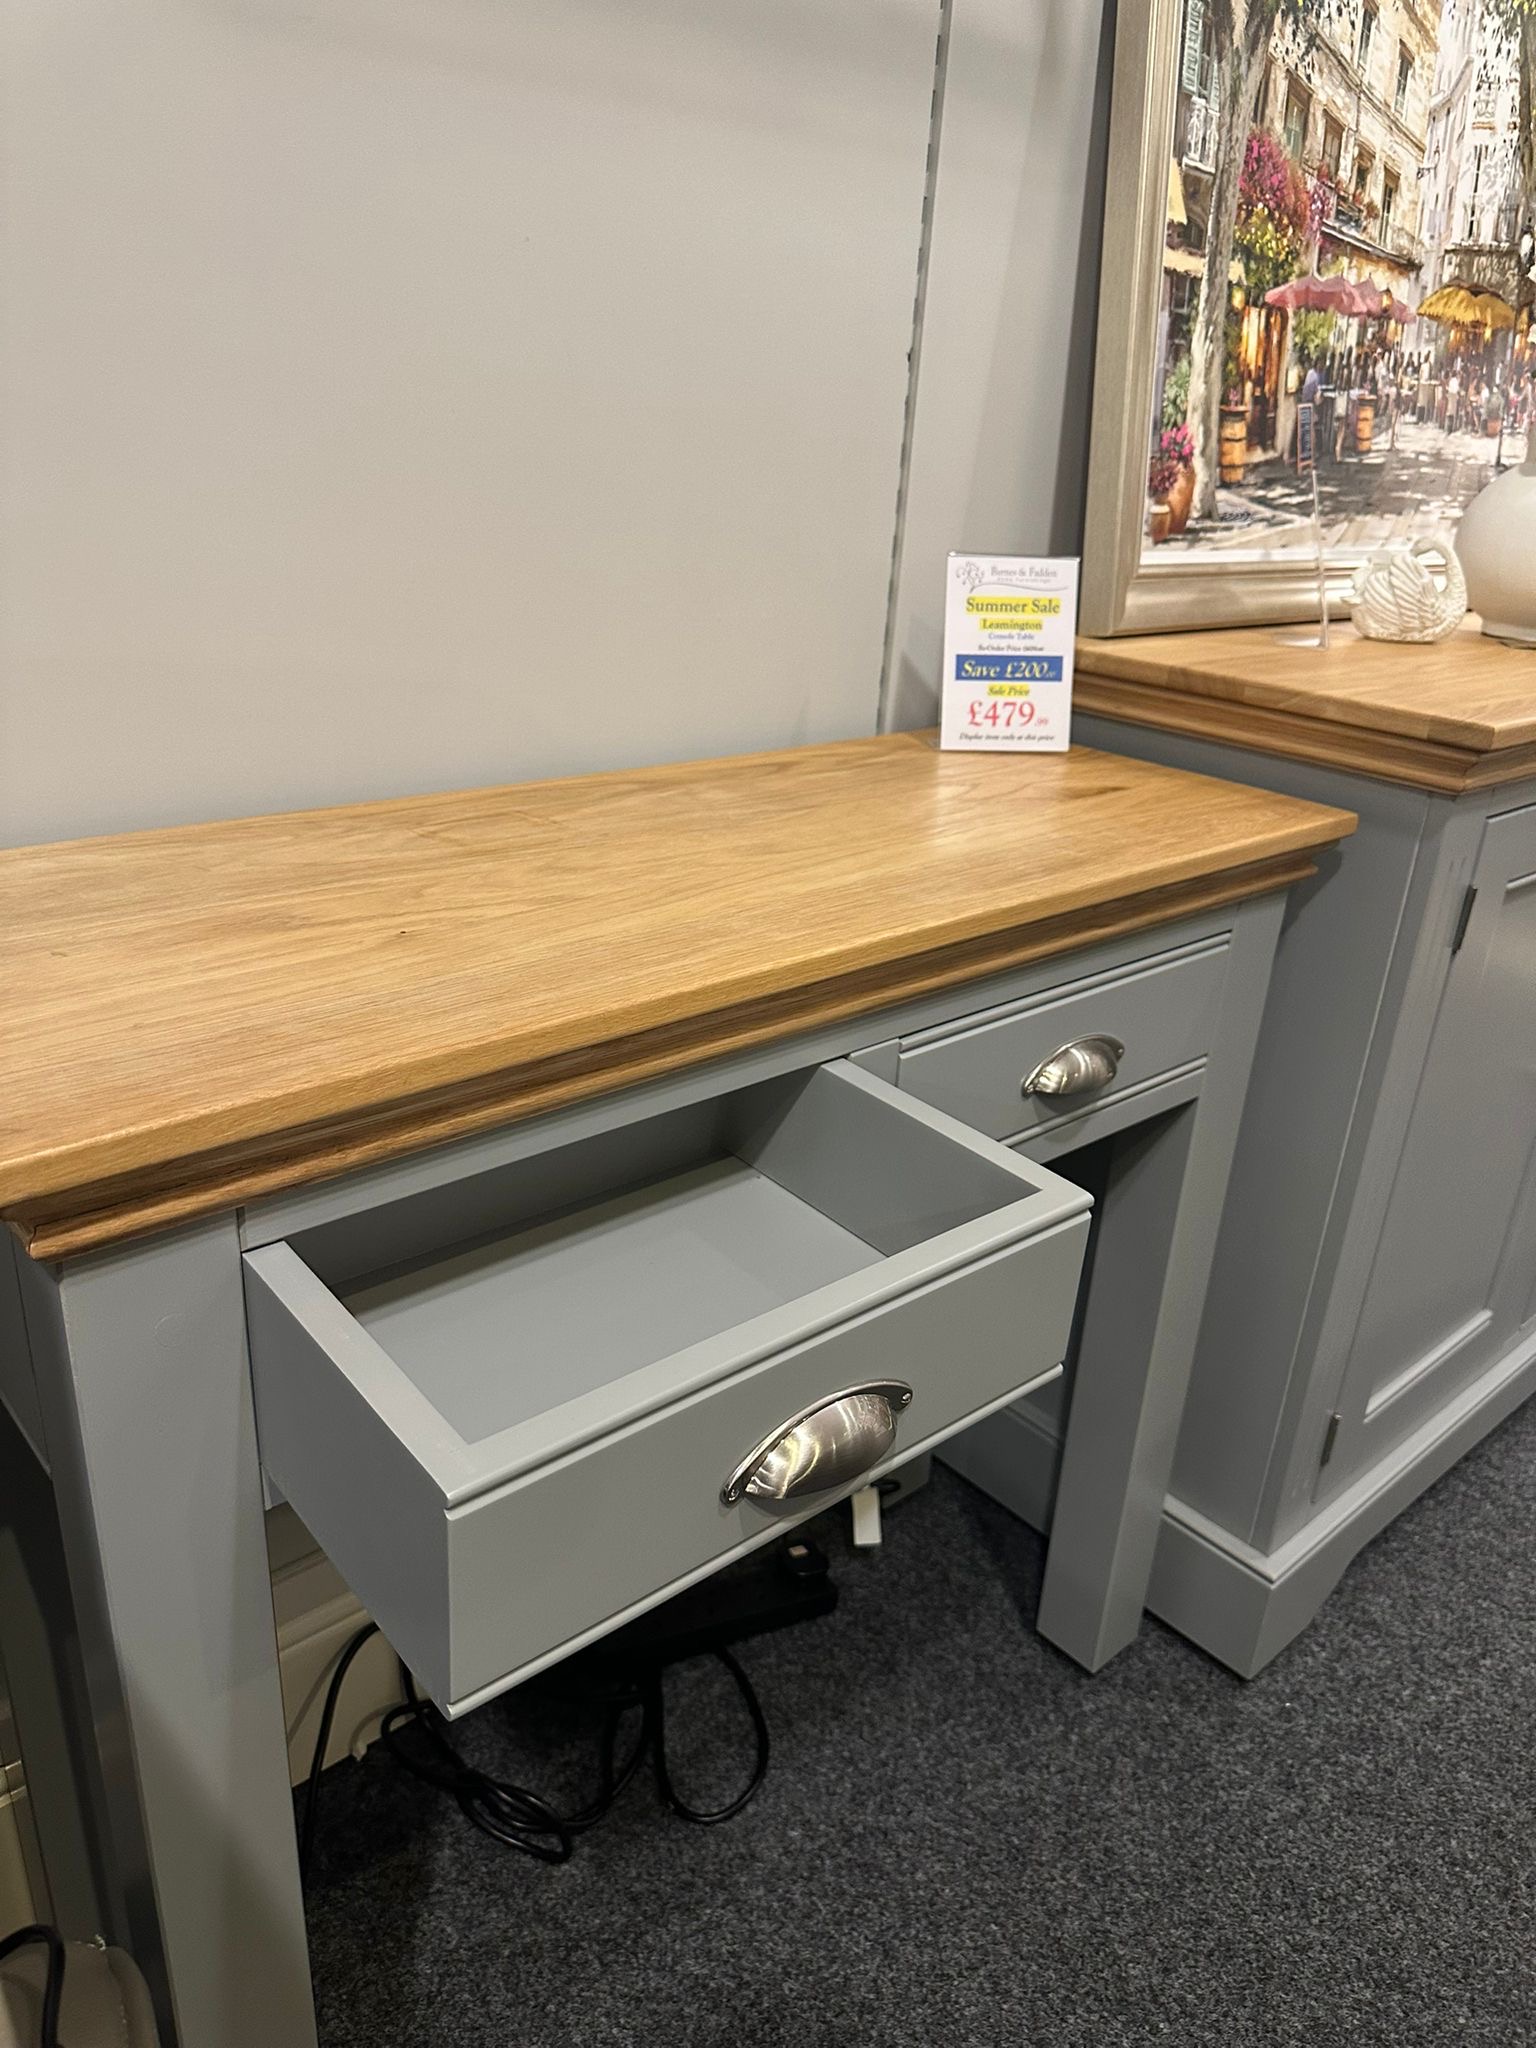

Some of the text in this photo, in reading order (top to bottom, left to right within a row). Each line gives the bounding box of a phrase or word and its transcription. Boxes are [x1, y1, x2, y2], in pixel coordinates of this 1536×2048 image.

[966, 597, 1060, 614] Summer Sale
[982, 619, 1043, 631] Leamington
[961, 660, 999, 678] Save
